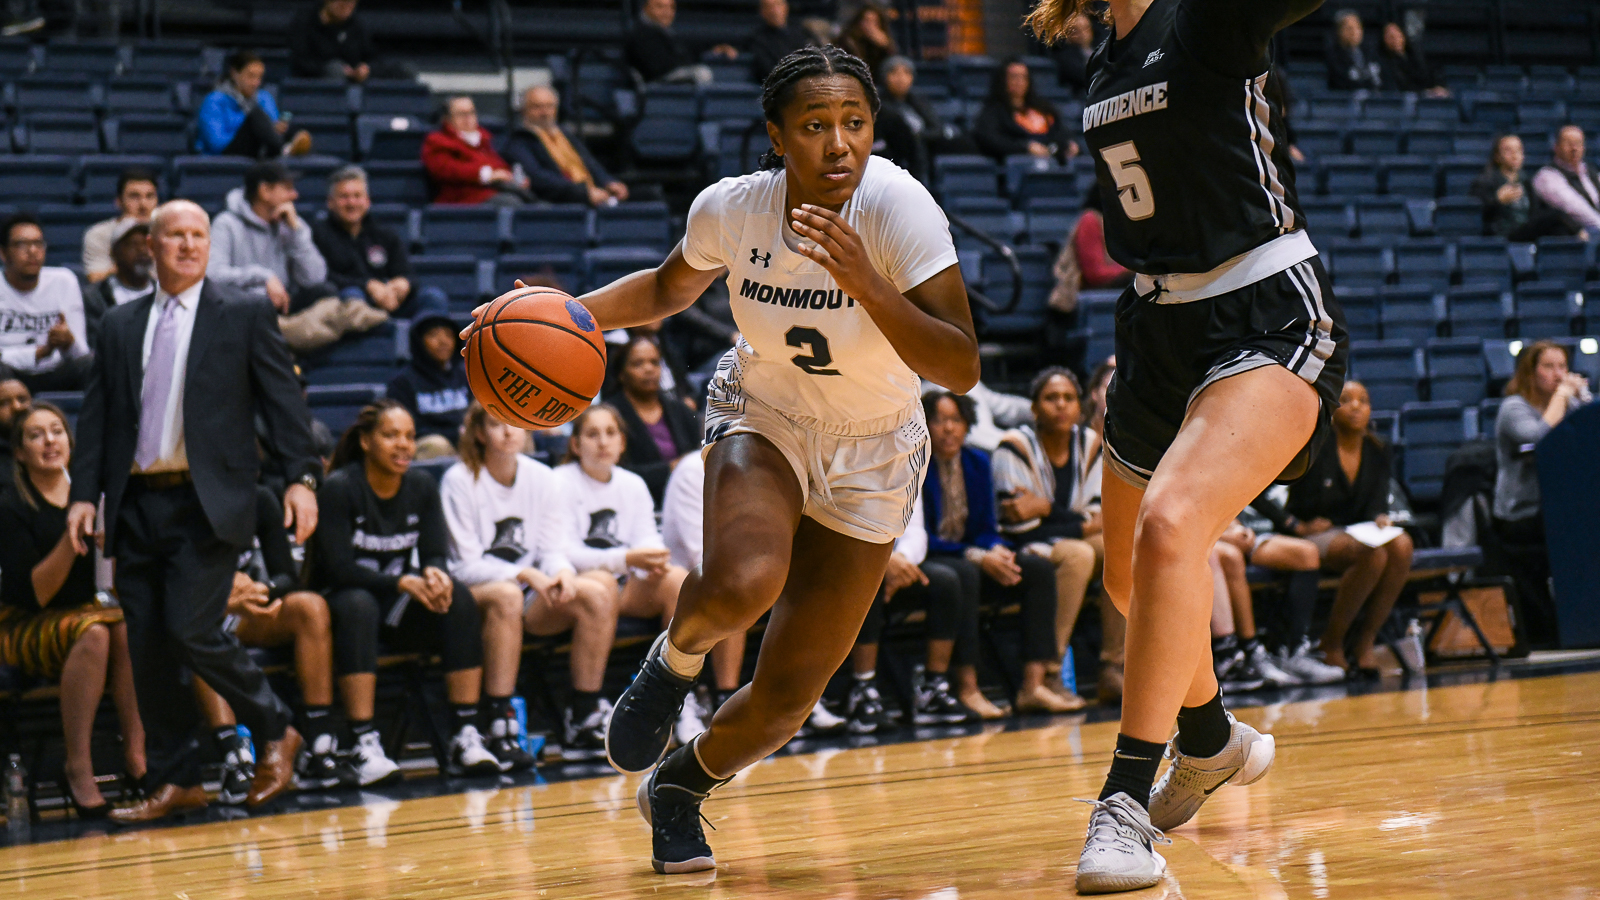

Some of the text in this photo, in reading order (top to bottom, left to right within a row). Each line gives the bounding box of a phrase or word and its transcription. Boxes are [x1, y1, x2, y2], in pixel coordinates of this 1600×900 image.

[1083, 81, 1168, 133] ROVIDENCE
[1099, 140, 1155, 221] 5
[740, 278, 862, 310] MONMOU
[784, 325, 843, 376] 2
[497, 367, 542, 409] THE
